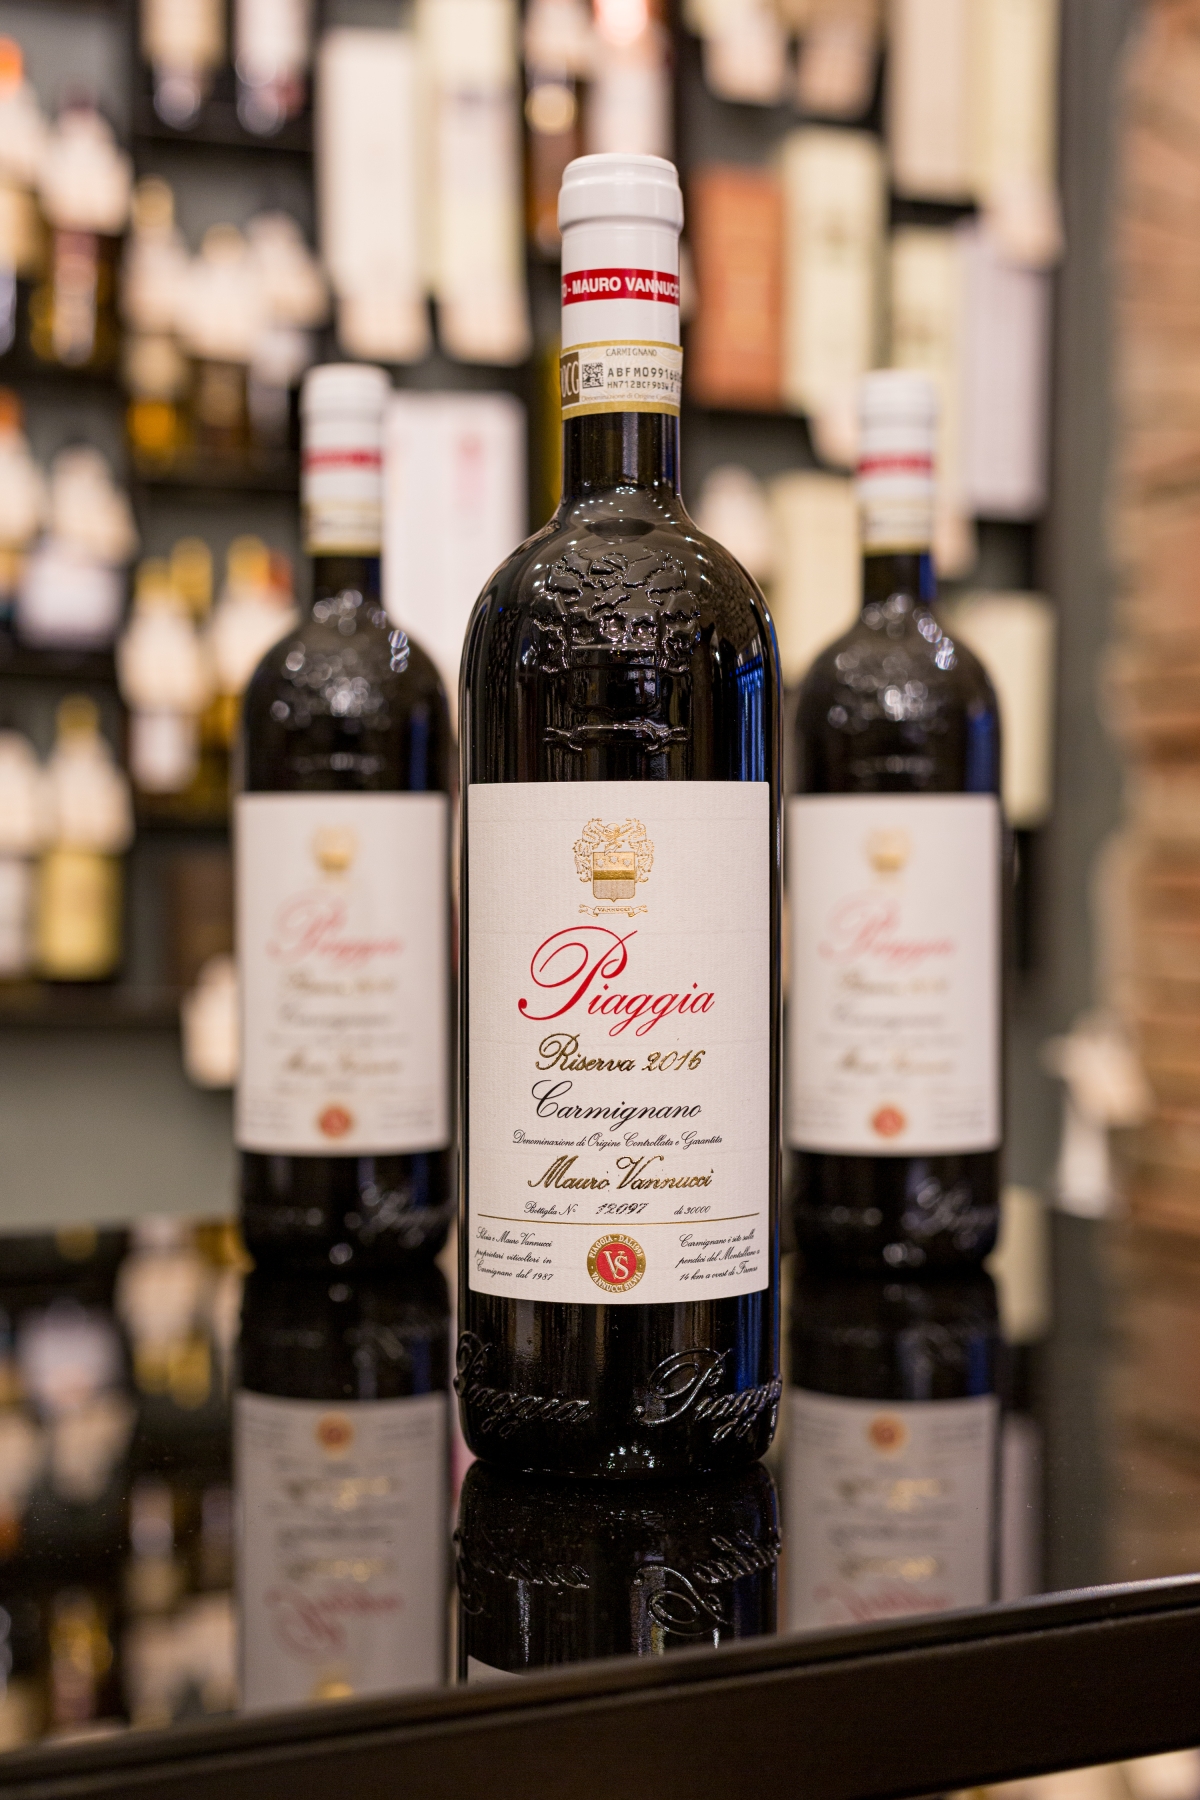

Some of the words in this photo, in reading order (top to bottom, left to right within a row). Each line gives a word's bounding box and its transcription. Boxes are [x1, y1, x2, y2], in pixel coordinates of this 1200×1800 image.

[572, 276, 622, 295] MAURO
[605, 347, 658, 357] CARMIGNANO
[518, 925, 715, 1036] Piaggia
[535, 1032, 636, 1072] Riserva
[641, 1049, 706, 1072] 2016
[531, 1079, 702, 1132] Carmignano
[512, 1129, 575, 1146] Denominazione
[575, 1135, 587, 1147] di
[587, 1131, 622, 1151] Origine
[623, 1131, 674, 1147] Controllata
[681, 1130, 723, 1150] Garantita
[527, 1154, 610, 1190] Mauro
[616, 1154, 714, 1190] Vannucci
[523, 1200, 558, 1218] Bottiglia
[673, 1204, 683, 1216] di
[683, 1205, 711, 1215] 30000
[495, 1230, 519, 1244] Mauro
[520, 1232, 553, 1248] Vannucci
[678, 1233, 727, 1250] Carmignano
[506, 1251, 541, 1264] viticoltori
[542, 1257, 553, 1265] in
[674, 1253, 706, 1269] pendici
[706, 1249, 722, 1262] del
[475, 1258, 513, 1278] Carmignano
[515, 1268, 533, 1279] dal
[531, 1272, 555, 1281] 1987
[679, 1273, 690, 1281] 14
[690, 1268, 704, 1281] km
[591, 1271, 625, 1293] VANNUCCI
[623, 1271, 644, 1291] SILVIA
